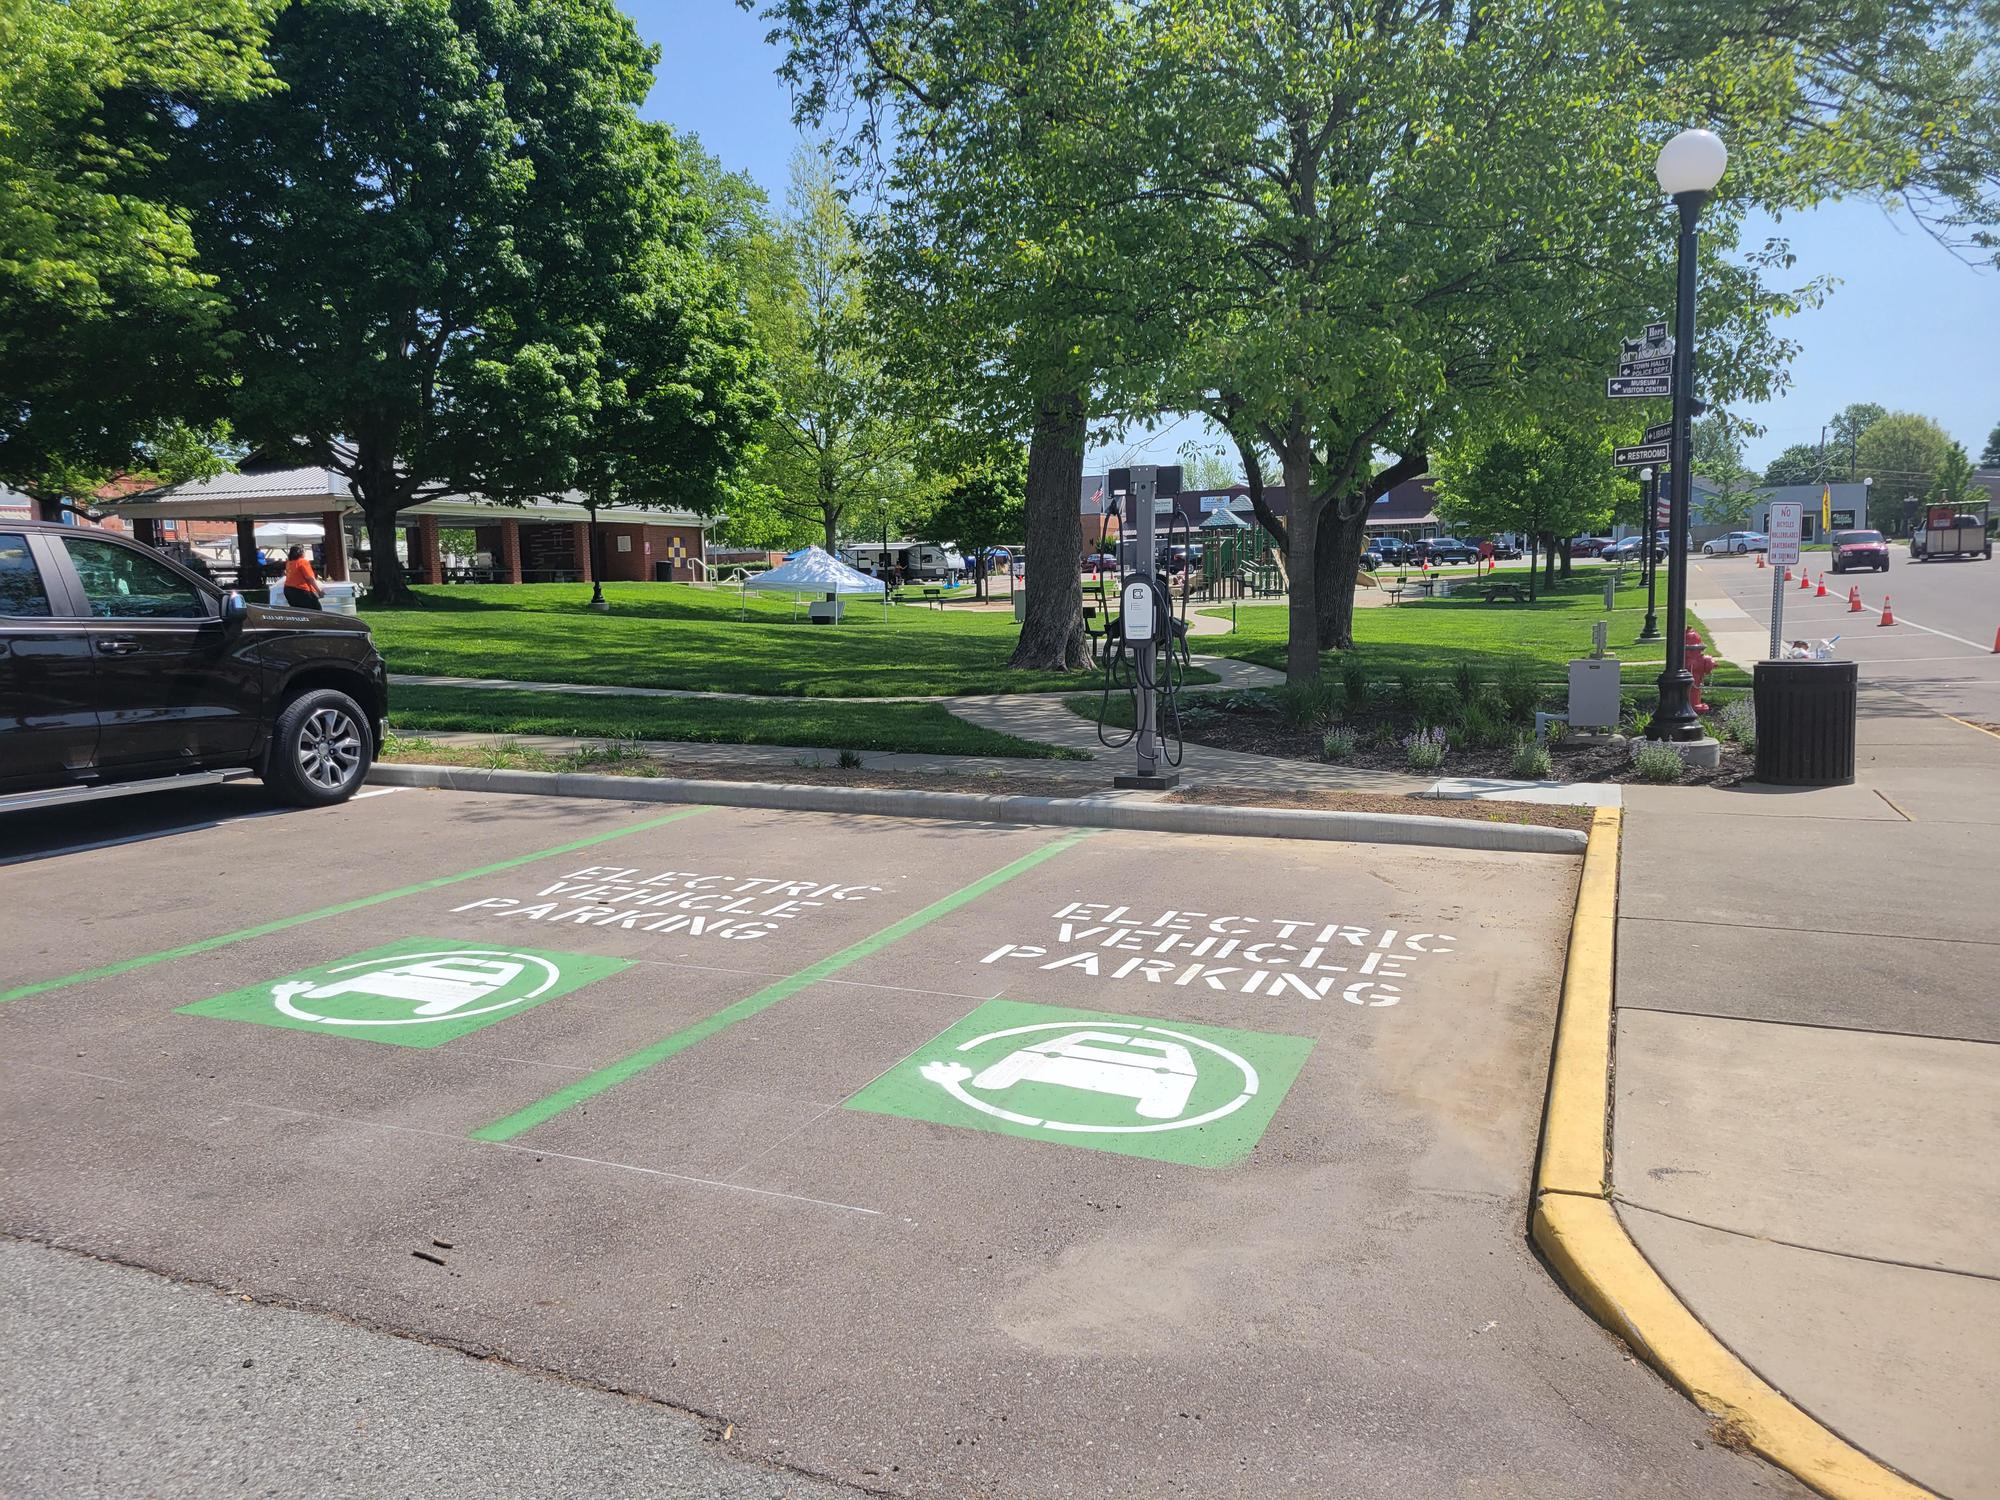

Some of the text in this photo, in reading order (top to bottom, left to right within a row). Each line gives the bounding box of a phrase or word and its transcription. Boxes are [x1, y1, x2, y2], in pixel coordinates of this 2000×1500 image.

[1632, 368, 1653, 376] POLICE
[1633, 362, 1650, 370] TOWN
[1645, 385, 1667, 393] CENTER
[1627, 448, 1666, 460] RESTROOMS
[1781, 509, 1791, 517] NO
[536, 881, 825, 919] VEHICLE
[560, 866, 883, 901] ELECTRIC
[449, 897, 779, 940] PARKING
[1051, 902, 1458, 953] ELECTRIC
[1057, 923, 1417, 978] VEHICLE
[978, 943, 1403, 1007] PARKING
